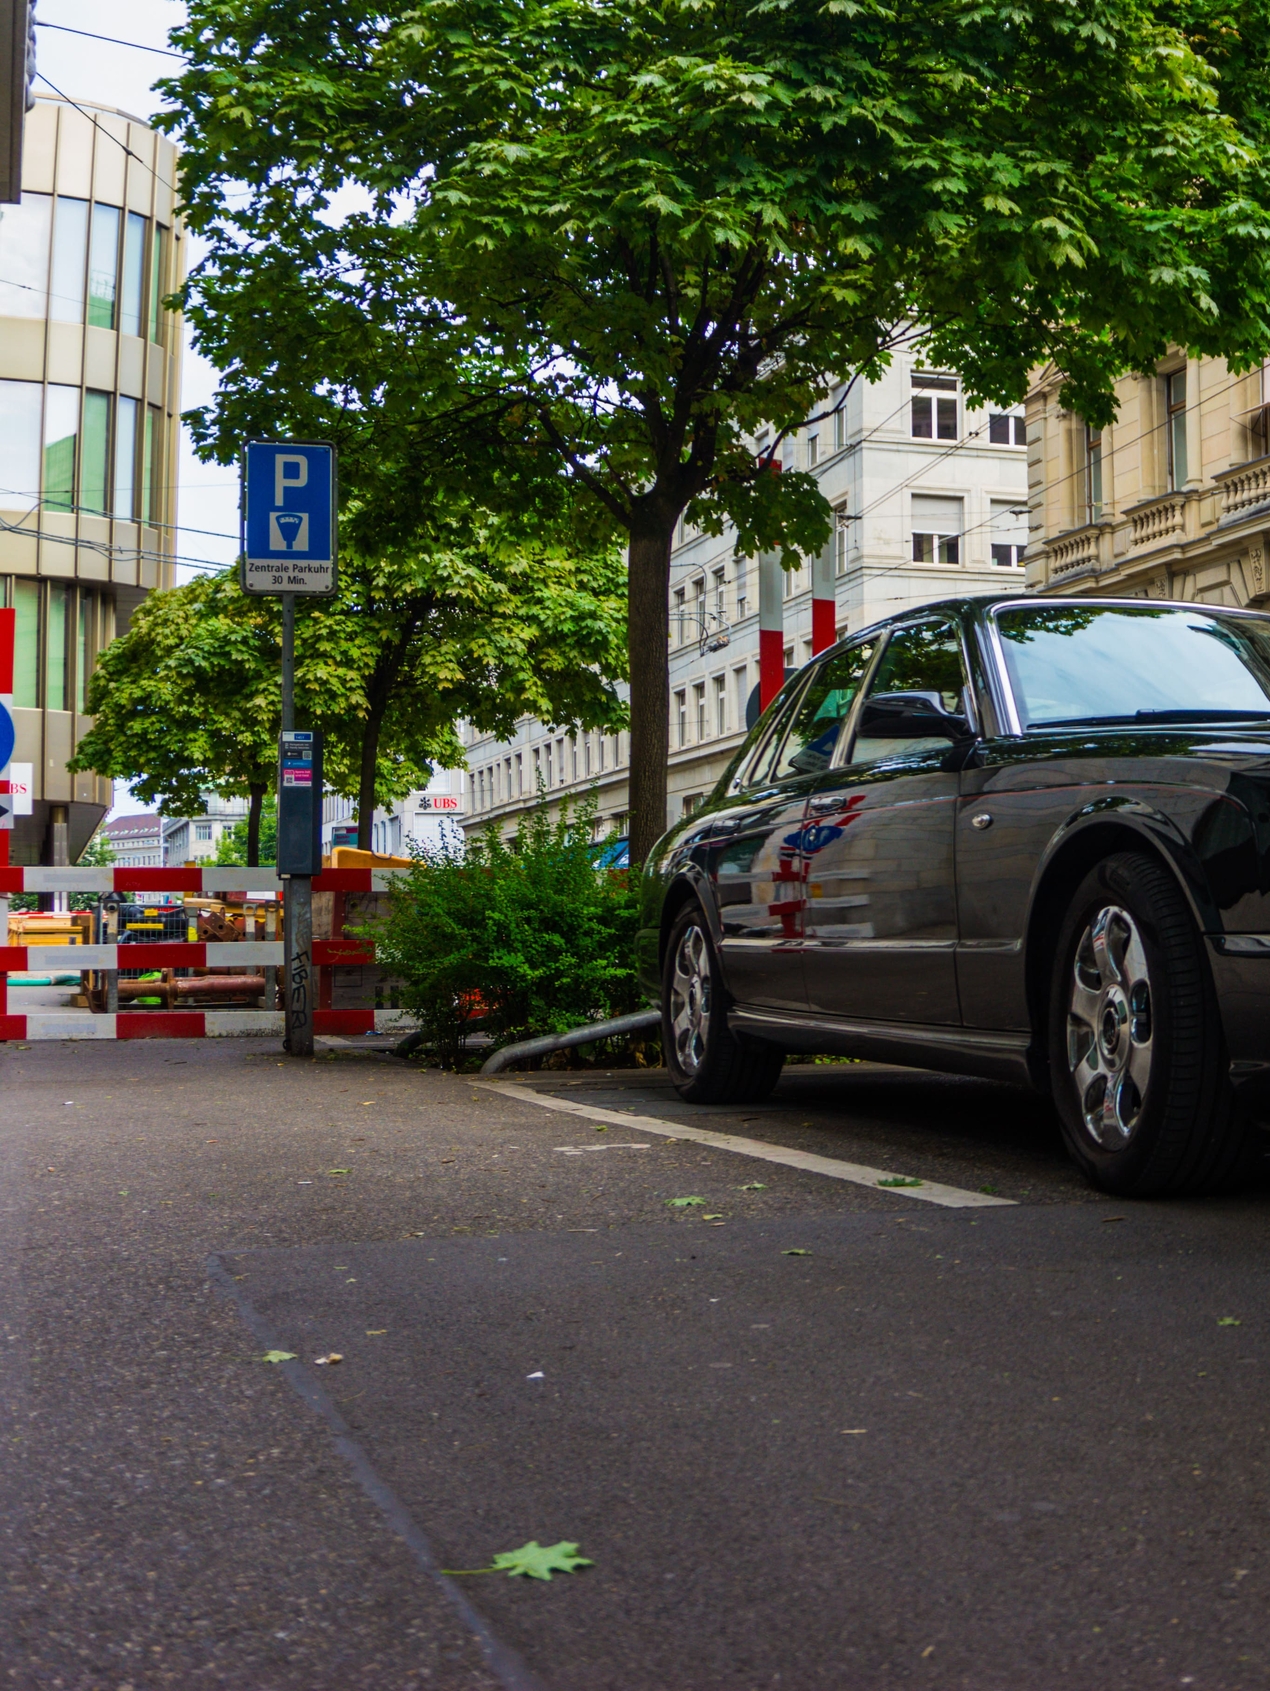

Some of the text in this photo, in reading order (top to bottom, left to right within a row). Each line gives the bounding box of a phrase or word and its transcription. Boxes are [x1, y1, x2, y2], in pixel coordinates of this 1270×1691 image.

[274, 453, 308, 507] P
[248, 563, 330, 574] Zentrale Parkuhr
[271, 575, 307, 585] 30 Min.
[433, 798, 458, 809] UBS
